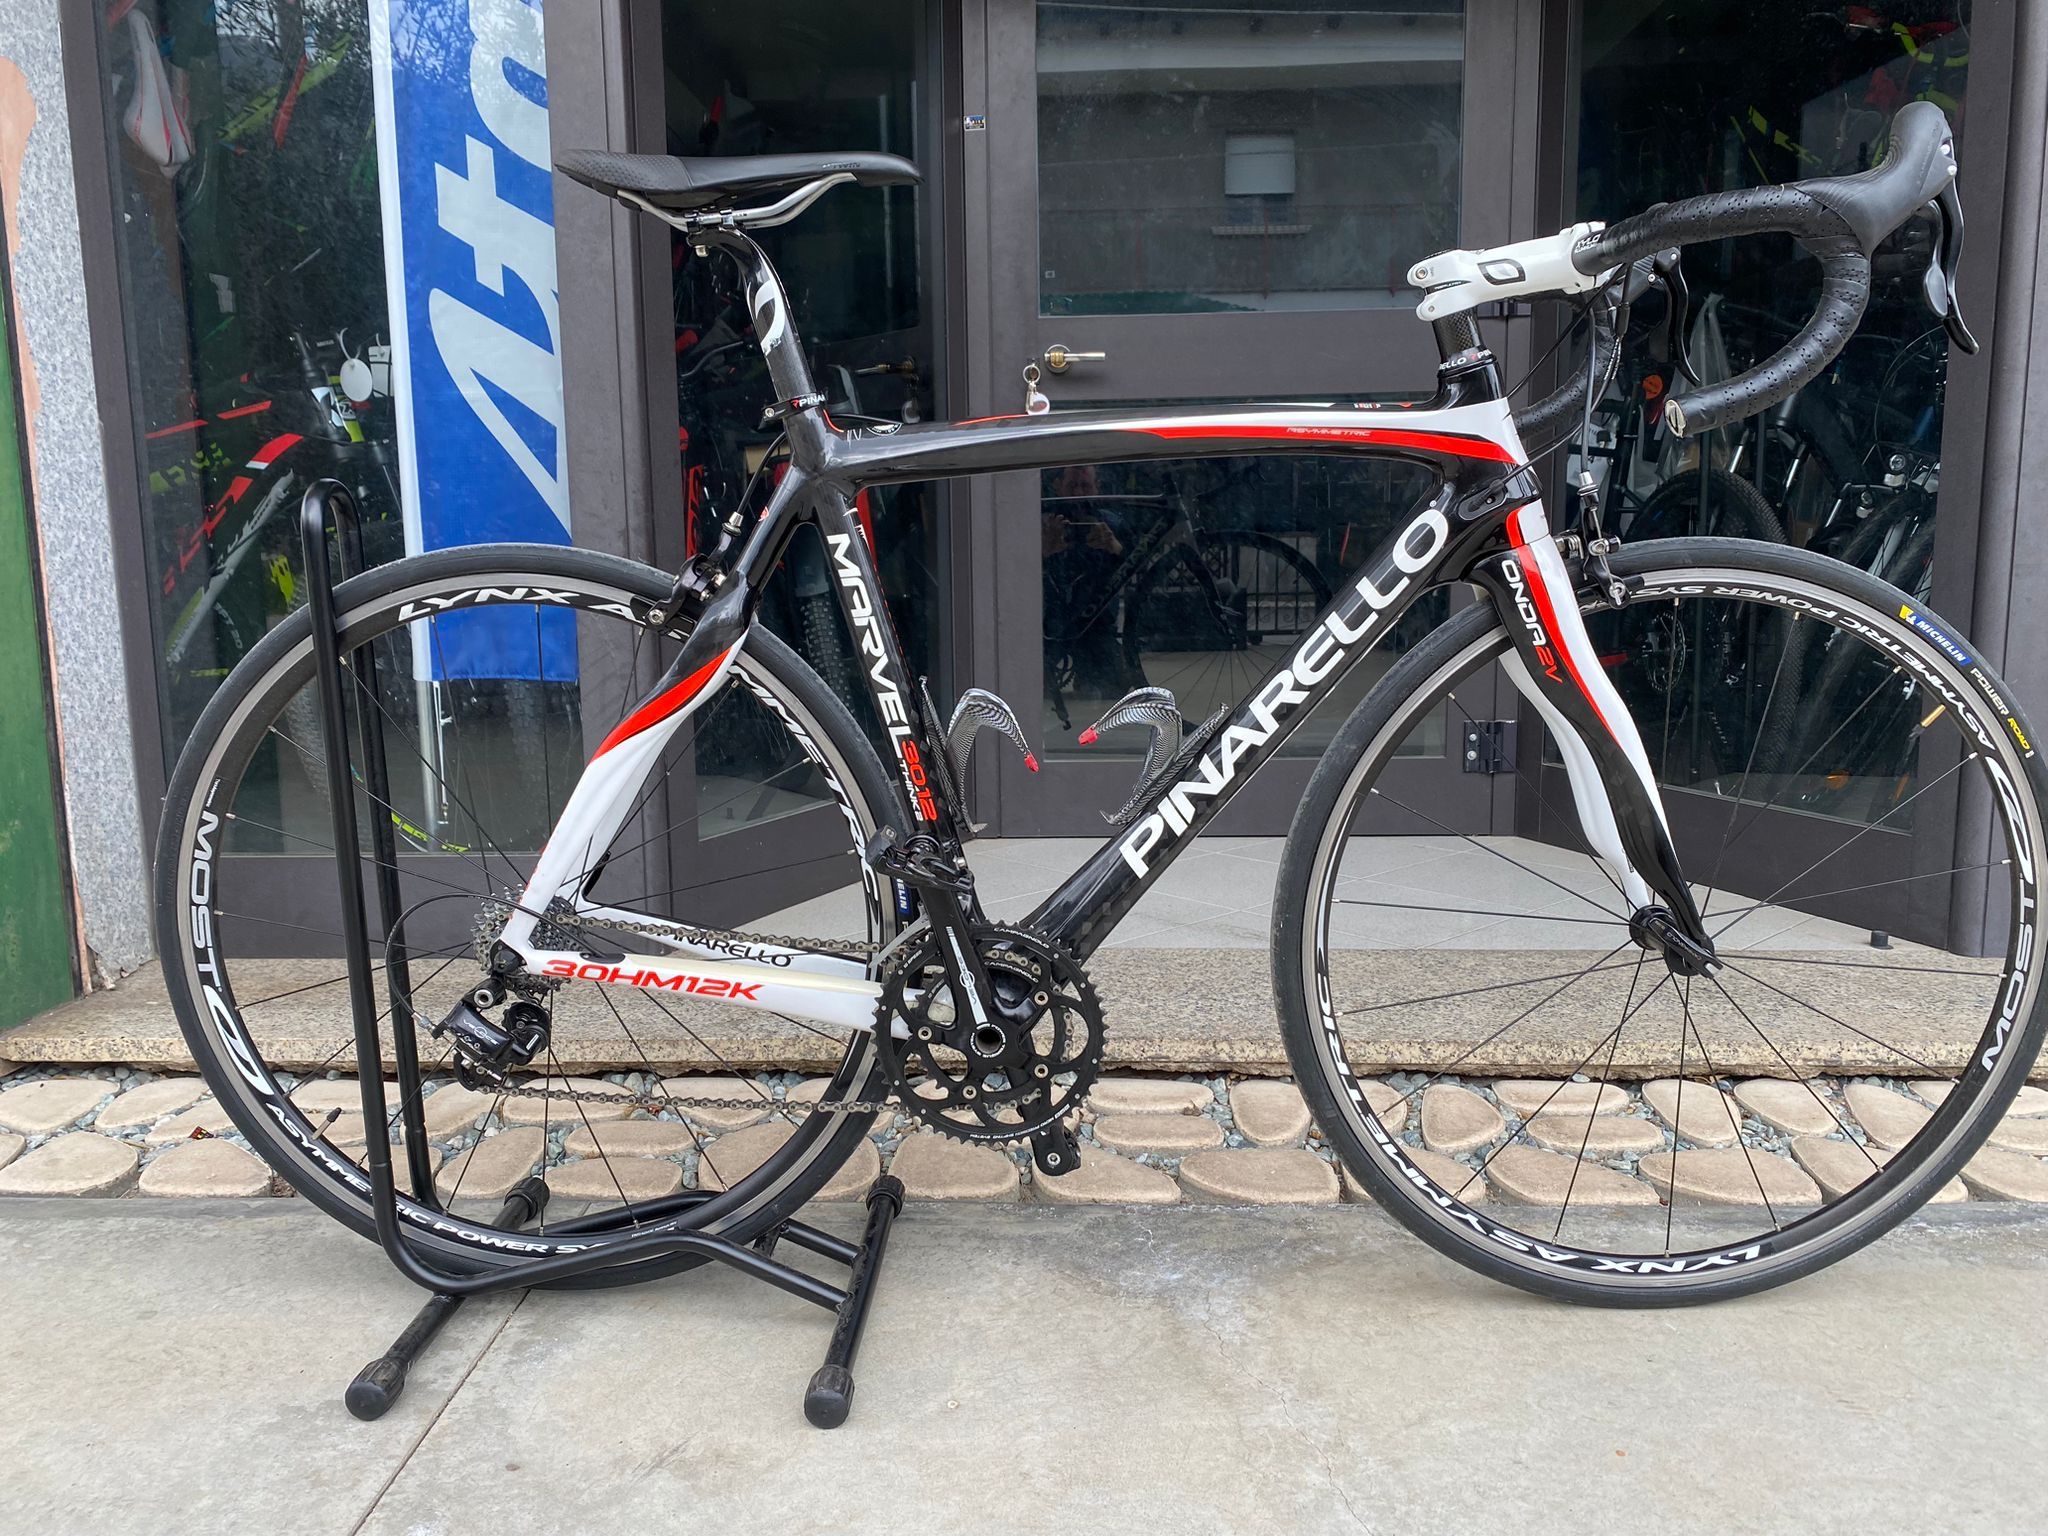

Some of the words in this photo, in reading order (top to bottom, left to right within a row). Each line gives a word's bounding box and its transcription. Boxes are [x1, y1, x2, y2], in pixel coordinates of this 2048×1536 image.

[1286, 427, 1373, 437] ASYMMETRIC
[398, 587, 580, 622] LYNX
[1712, 586, 1838, 623] POWER
[826, 533, 912, 759] MARVEL
[1915, 620, 1966, 662] MICHELIN
[1118, 508, 1449, 879] PINARELLO
[1839, 616, 1996, 751] ASYMMETRIC
[1970, 668, 2009, 715] POWER
[2007, 717, 2031, 750] ROAD
[191, 810, 221, 989] MOST
[993, 927, 1050, 949] CAMPAGNOLO
[541, 959, 765, 1001] 30HM12K
[983, 961, 1040, 984] CAMPAGNOLO
[1981, 877, 2034, 1072] MOST
[1317, 972, 1579, 1262] ASYMMETRIC
[266, 1102, 434, 1224] ASYMMERIC
[432, 1222, 549, 1254] POWER
[1591, 1244, 1760, 1273] LYNX
